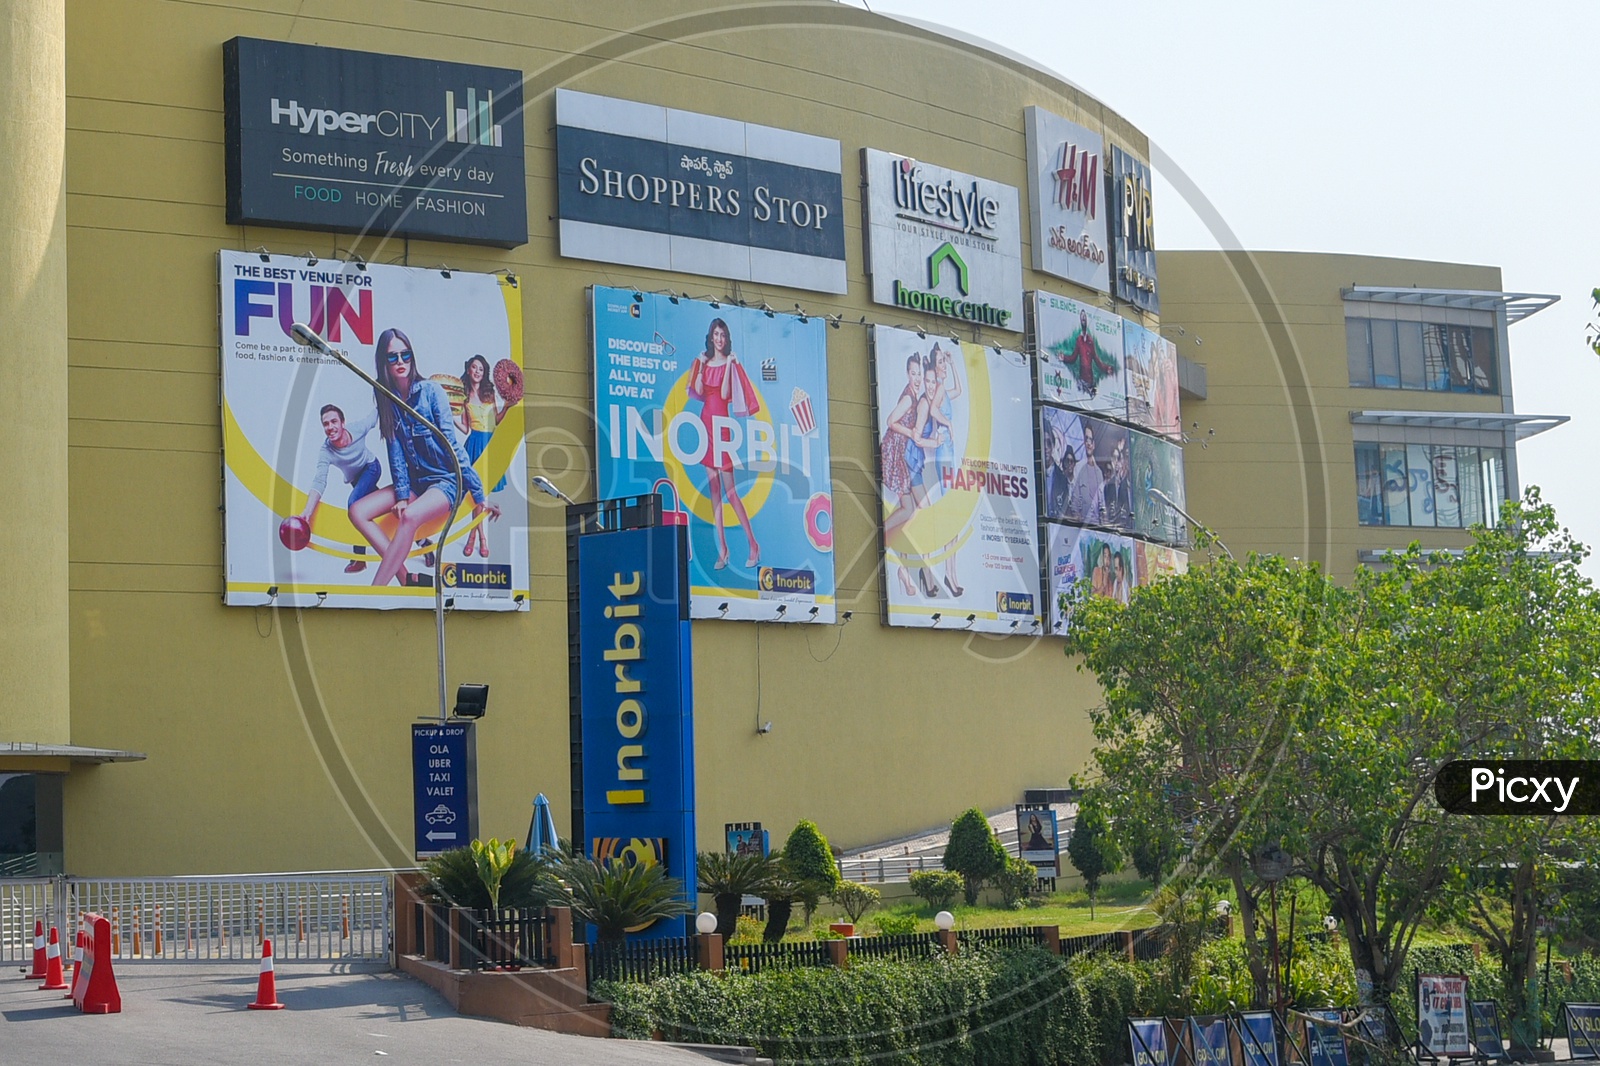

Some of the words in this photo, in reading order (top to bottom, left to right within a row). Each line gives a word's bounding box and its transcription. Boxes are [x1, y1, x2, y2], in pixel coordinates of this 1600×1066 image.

[270, 97, 441, 141] HyperCITY
[282, 148, 368, 172] Something
[375, 150, 415, 178] Fresh
[420, 165, 462, 181] every
[467, 166, 495, 184] day
[1054, 141, 1098, 221] H&M
[294, 185, 342, 203] FOOD
[355, 191, 403, 208] HOME
[415, 197, 486, 216] FASHION
[579, 157, 740, 217] SHOPPERS
[753, 186, 829, 230] STOP
[894, 158, 999, 233] lifestyle
[1123, 172, 1155, 252] PVR
[896, 222, 917, 235] YOUR
[950, 235, 970, 247] YOUR
[234, 264, 260, 278] THE
[263, 268, 296, 281] BEST
[299, 270, 343, 285] VENUE
[346, 275, 372, 287] FOR
[894, 279, 1009, 327] homecentre
[1050, 298, 1077, 314] SILENCE
[234, 278, 374, 345] FUN
[235, 342, 259, 350] Come
[260, 342, 271, 351] be
[280, 345, 296, 355] part
[341, 348, 349, 357] in
[608, 337, 664, 355] DISCOVER
[235, 352, 257, 361] food,
[258, 353, 287, 362] fashion
[288, 355, 294, 363] &
[296, 356, 346, 367] entertainme
[608, 353, 631, 366] THE
[632, 356, 660, 370] BEST
[662, 360, 678, 372] OF
[609, 369, 631, 382] ALL
[633, 371, 656, 385] YOU
[609, 384, 639, 398] LOVE
[640, 388, 655, 400] AT
[609, 403, 820, 478] INORBIT
[961, 458, 989, 470] WELCOME
[990, 463, 999, 471] TO
[1000, 464, 1028, 475] UNLIMITED
[942, 466, 1029, 499] HAPPINESS
[986, 534, 1004, 542] INORBIT
[461, 569, 507, 585] Inorbit
[776, 574, 811, 589] Inorbit
[1009, 597, 1032, 611] Inorbit
[603, 570, 646, 805] Inorbit
[414, 729, 438, 737] PICKUP
[445, 728, 464, 736] DROP
[429, 745, 449, 754] OLA
[428, 759, 451, 768] UBER
[429, 773, 451, 782] TAXI
[426, 787, 454, 796] VALET
[1571, 1016, 1584, 1031] GO
[1584, 1016, 1600, 1031] SLO
[1256, 1041, 1273, 1055] SOW
[1574, 1038, 1595, 1047] SECUTY
[1137, 1051, 1148, 1065] GO
[1196, 1048, 1207, 1061] GO
